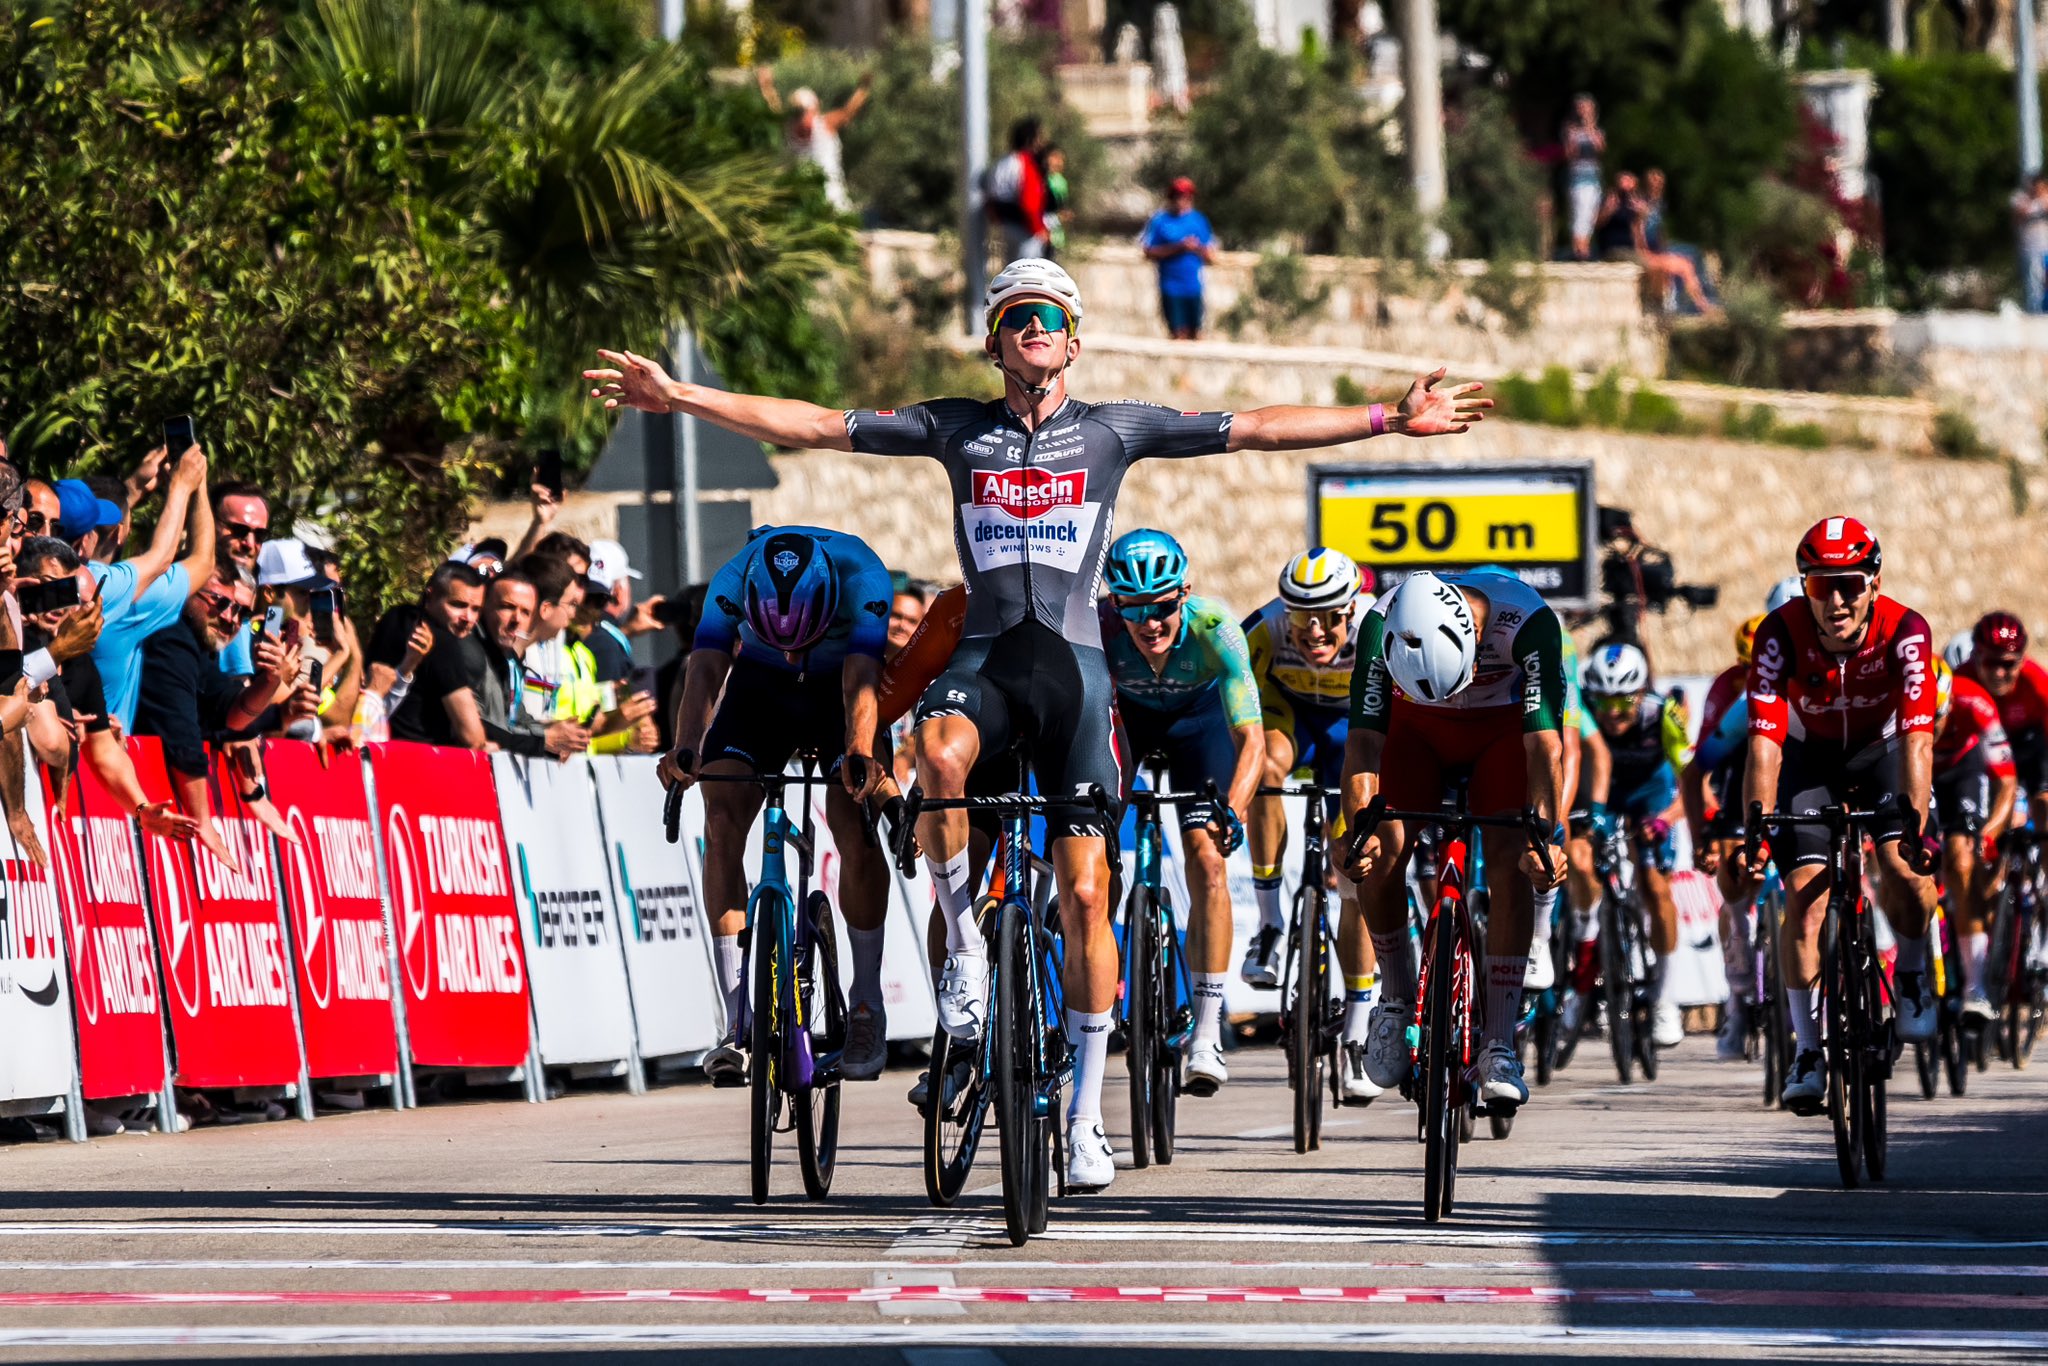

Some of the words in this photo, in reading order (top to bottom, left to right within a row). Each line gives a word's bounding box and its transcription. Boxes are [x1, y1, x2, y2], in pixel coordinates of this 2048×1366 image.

[1037, 435, 1084, 450] CANYON
[982, 475, 1073, 506] Alpecin
[982, 496, 1009, 505] HAIR
[1015, 496, 1073, 507] BOOSTER
[974, 519, 1078, 543] deceuninck
[1368, 501, 1457, 553] 50
[1487, 522, 1535, 550] m
[1523, 650, 1541, 714] KOMETA
[71, 816, 141, 905] TURKISH
[313, 815, 378, 900] TURKISH
[418, 814, 508, 896] TURKISH
[93, 926, 158, 1015] AIRLINES
[203, 922, 288, 1007] AIRLINES
[435, 914, 523, 995] AIRLINES
[1491, 965, 1525, 975] POLT
